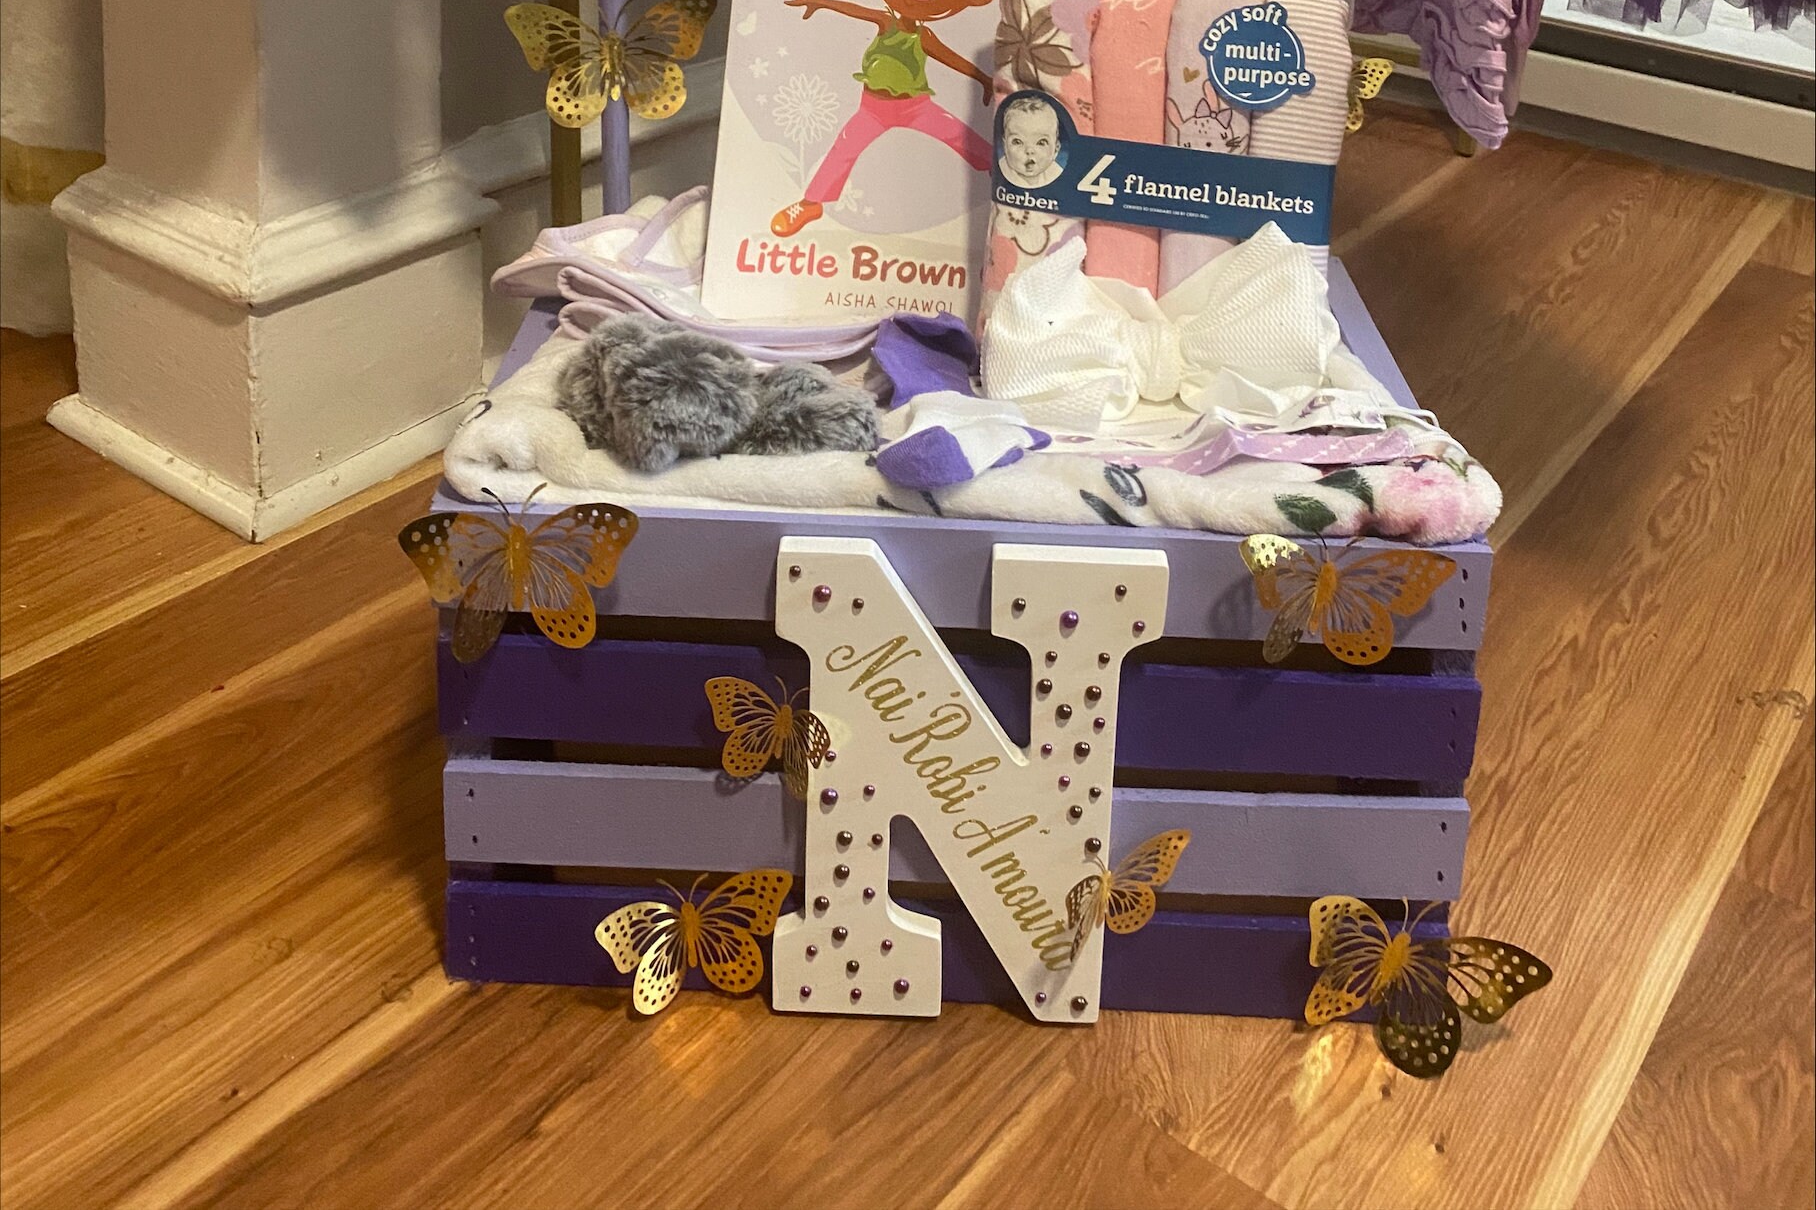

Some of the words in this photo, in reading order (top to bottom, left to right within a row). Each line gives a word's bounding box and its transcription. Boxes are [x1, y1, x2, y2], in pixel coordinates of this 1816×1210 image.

[1203, 12, 1238, 52] cozy
[1241, 4, 1282, 26] soft
[1225, 41, 1292, 62] multi-
[1224, 65, 1311, 88] purpose
[1077, 154, 1117, 206] 4
[1123, 173, 1210, 203] flannel
[1215, 185, 1314, 214] blankets
[996, 185, 1058, 210] Gerber
[736, 238, 839, 278] Little
[851, 245, 967, 289] Brown
[825, 292, 876, 308] AISHA
